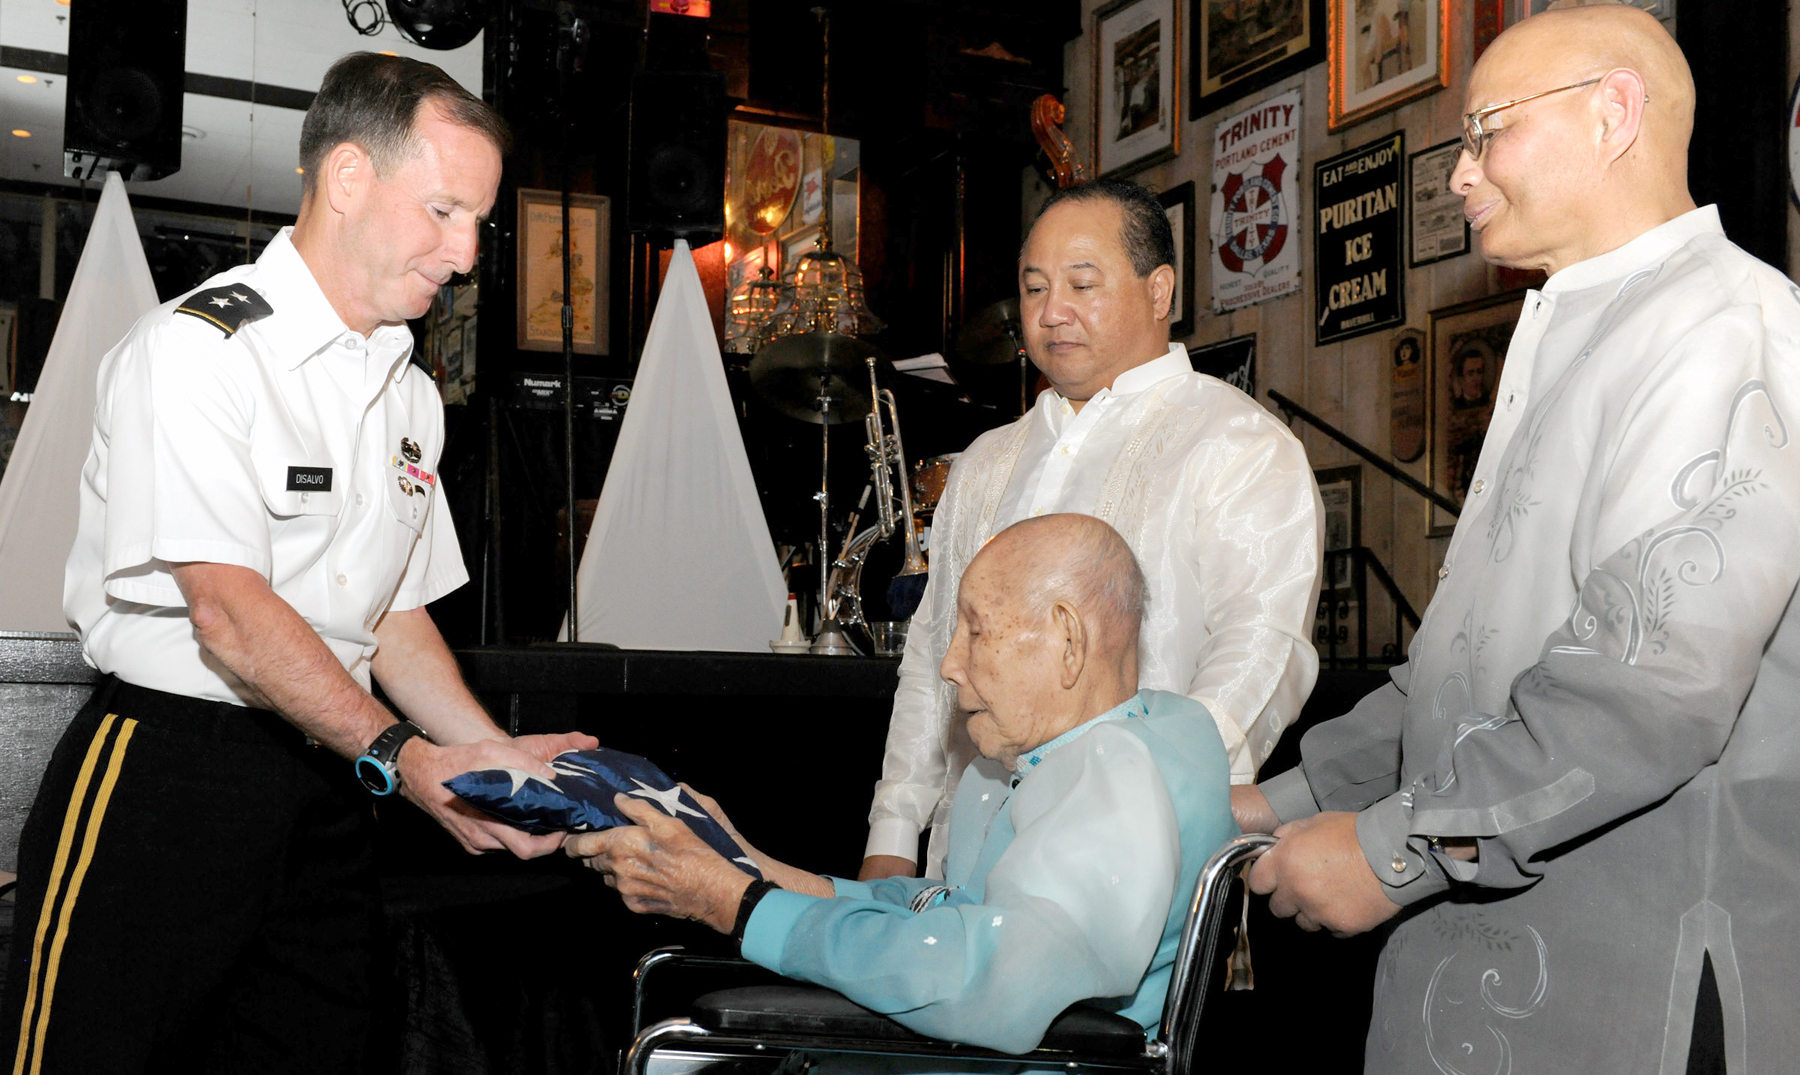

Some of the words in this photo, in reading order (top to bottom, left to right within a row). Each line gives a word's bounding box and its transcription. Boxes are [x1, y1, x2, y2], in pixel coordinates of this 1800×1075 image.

[1219, 104, 1294, 153] TRINITY
[1215, 144, 1258, 171] PORTLAND
[1260, 129, 1297, 153] CEMENT
[1322, 166, 1344, 187] EAT
[1344, 160, 1358, 173] AND
[1357, 145, 1396, 174] ENJOY
[1233, 207, 1271, 229] TRINITY
[1320, 182, 1398, 234] PURITAN
[1344, 232, 1373, 266] ICE
[1262, 280, 1290, 296] DEALERS
[1328, 268, 1387, 311] CREAM
[523, 378, 561, 388] Numark
[295, 473, 324, 485] DISALVO
